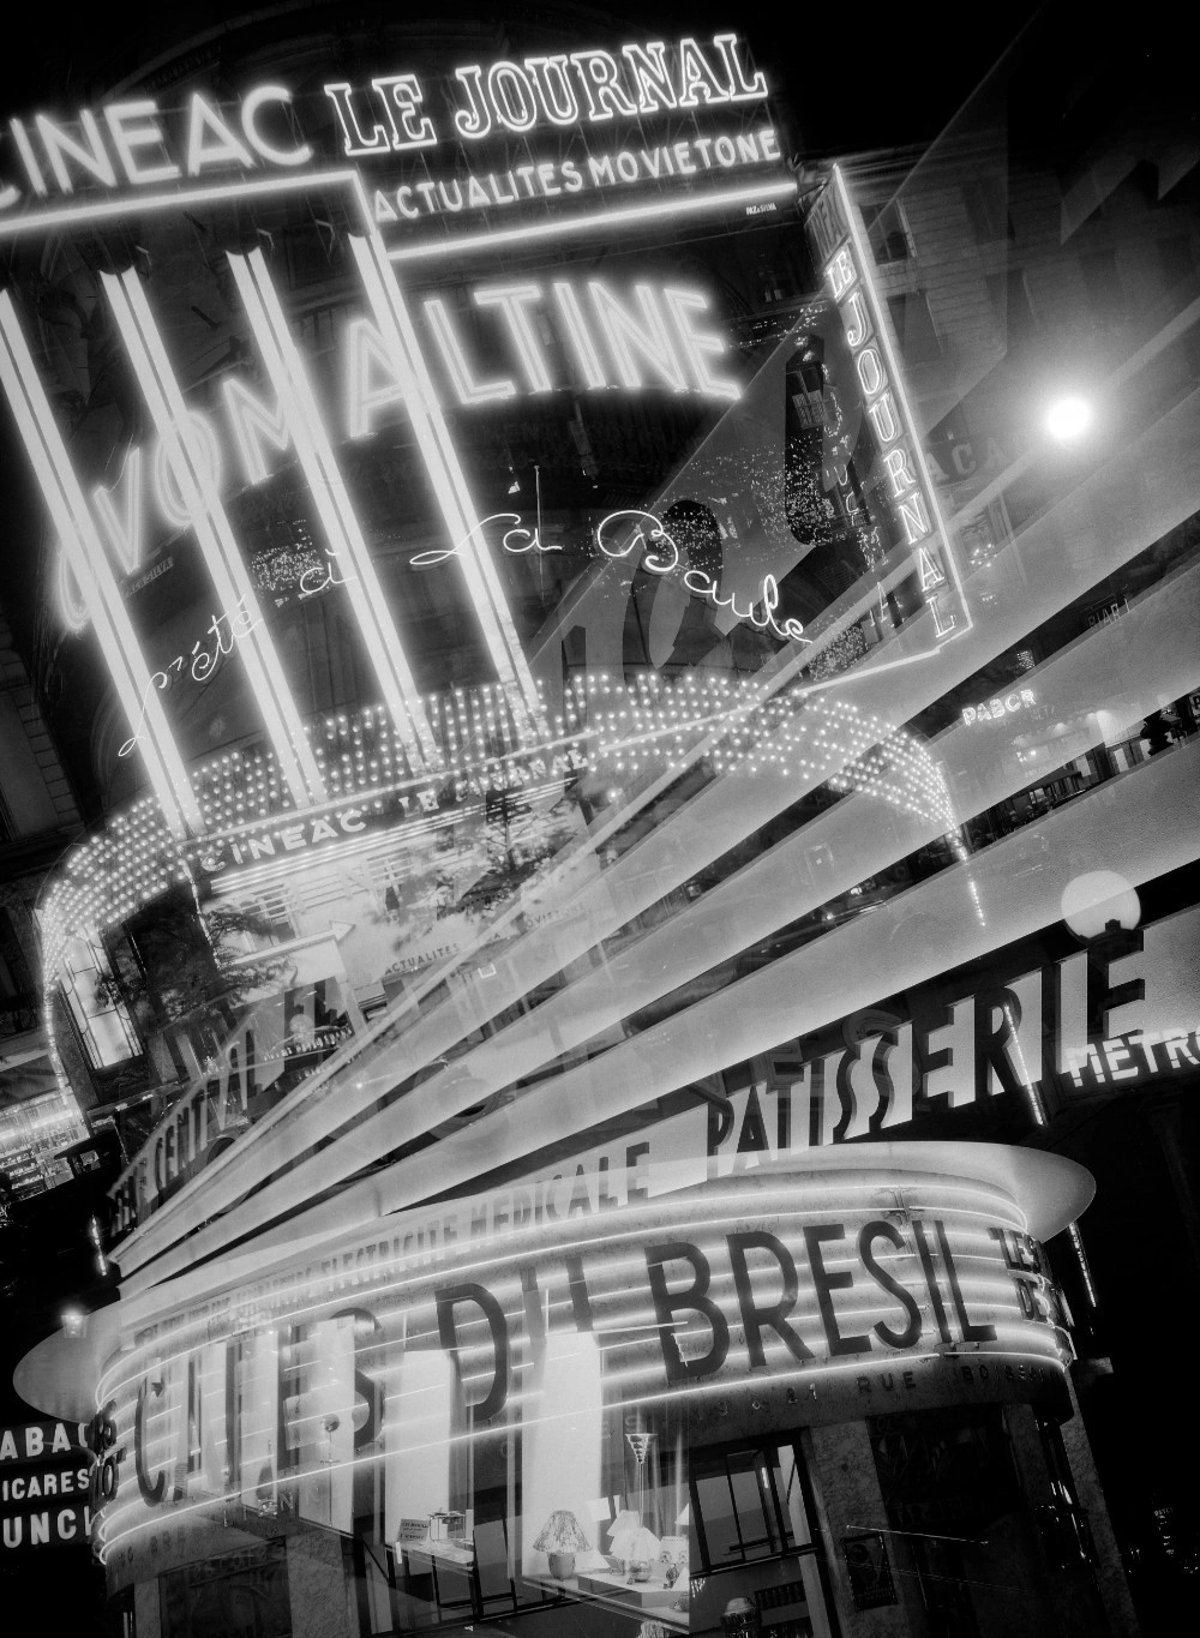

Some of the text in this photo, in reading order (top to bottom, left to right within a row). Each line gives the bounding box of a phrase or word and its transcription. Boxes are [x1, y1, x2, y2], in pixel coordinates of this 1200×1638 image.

[0, 85, 313, 209] INEAC
[323, 33, 769, 157] LE JOURNAL
[373, 129, 781, 223] ACTUALITES MOVIETONE
[56, 282, 743, 632] OVOMALTINE
[846, 291, 956, 639] JOURNAL
[409, 513, 563, 566] La
[598, 510, 813, 644] Baule
[200, 809, 369, 873] CINEAC
[706, 926, 1145, 1177] PATISSERIE
[468, 1141, 651, 1248] MEDICALE
[644, 1219, 997, 1384] BRESIL
[857, 1370, 917, 1394] RUE
